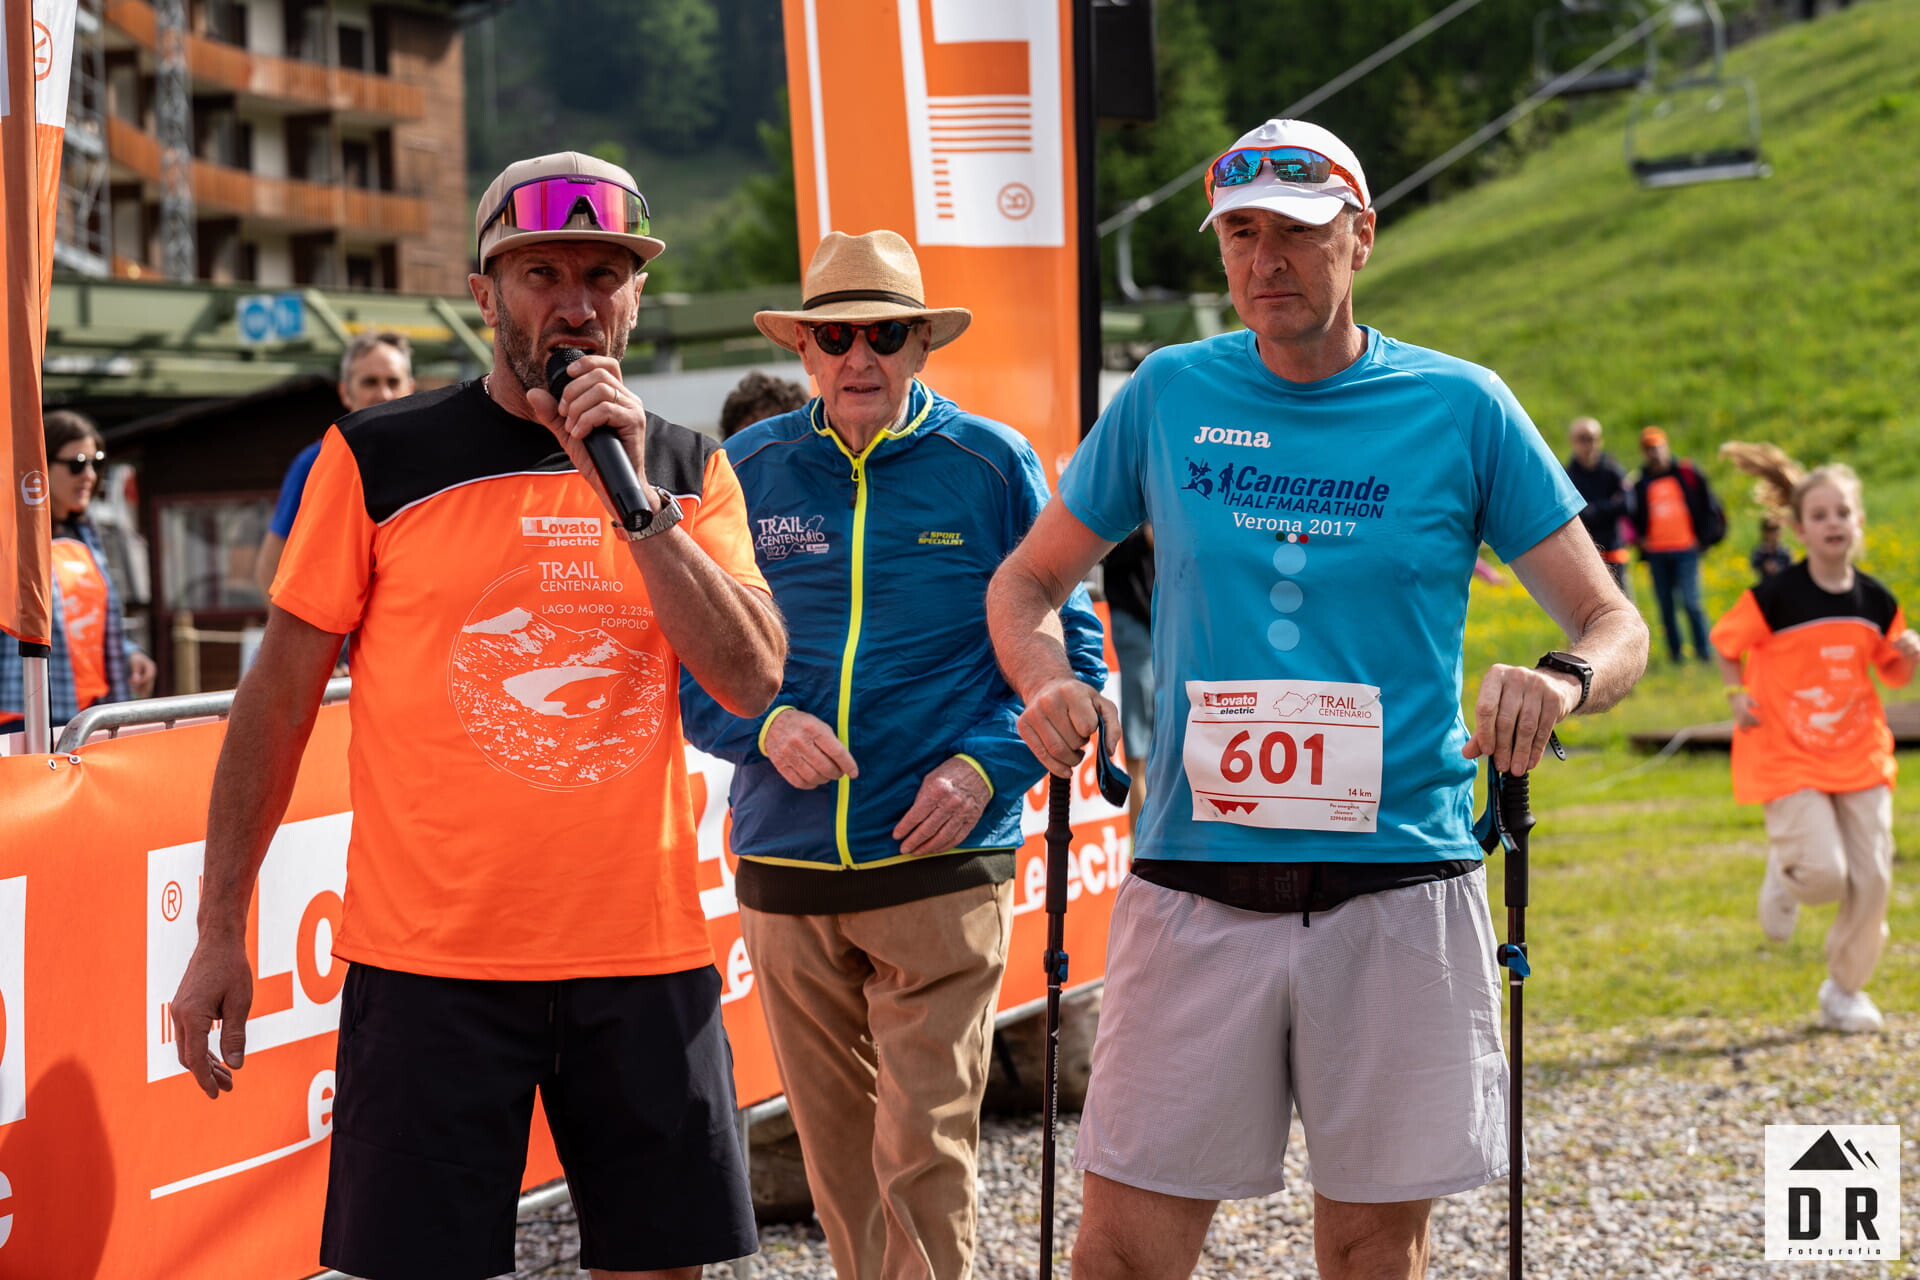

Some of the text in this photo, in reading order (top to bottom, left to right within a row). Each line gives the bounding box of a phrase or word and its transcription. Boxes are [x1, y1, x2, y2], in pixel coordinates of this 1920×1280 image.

[1228, 492, 1385, 519] HALFMARATHON
[536, 519, 599, 535] Lovato
[757, 516, 805, 535] TRAIL
[1232, 511, 1357, 537] Verona 2017
[547, 536, 600, 547] electric
[760, 531, 826, 547] CENTENARIO
[930, 531, 961, 539] SPORT
[538, 560, 600, 580] TRAIL
[540, 580, 624, 593] CENTENARIO
[541, 603, 574, 615] LAGO
[577, 603, 615, 615] MORO
[601, 617, 649, 630] FOPPOLO
[1212, 694, 1256, 707] Lovato
[1318, 694, 1357, 711] TRAIL
[1220, 707, 1255, 715] electric
[1318, 708, 1372, 719] CENTENARIO
[1219, 729, 1325, 786] 601
[1348, 788, 1372, 798] 14 km
